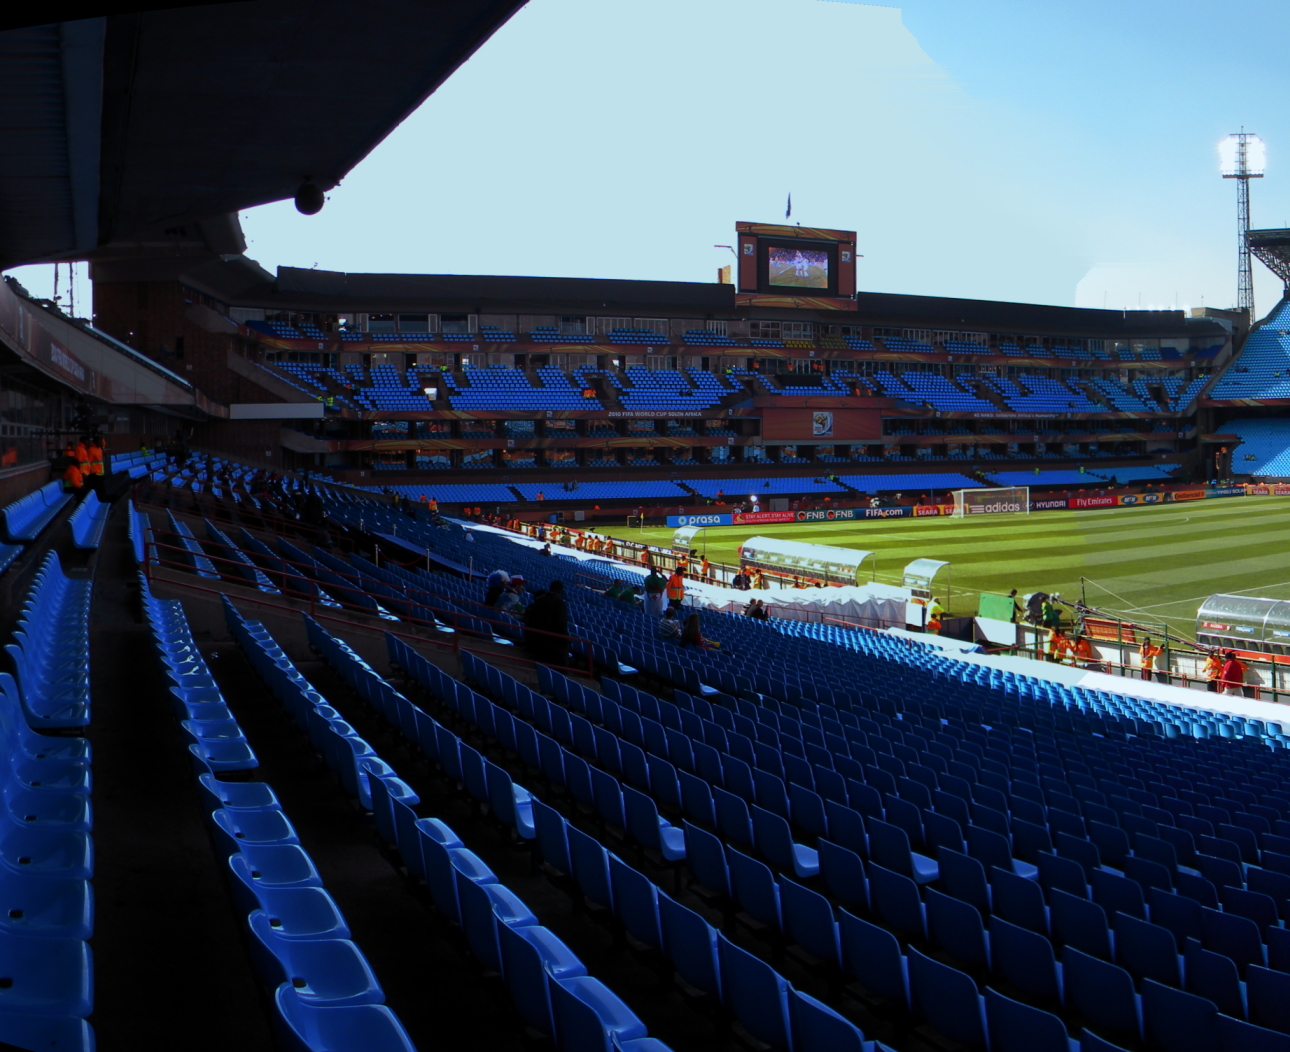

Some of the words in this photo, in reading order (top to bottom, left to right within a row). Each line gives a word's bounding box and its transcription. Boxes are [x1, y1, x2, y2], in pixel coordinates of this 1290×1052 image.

[1036, 500, 1066, 509] HYUNDAI
[1076, 498, 1087, 508] Fly
[1088, 497, 1112, 506] Emirates
[986, 502, 1020, 513] adidas
[806, 511, 824, 520] FNB
[835, 510, 854, 518] FNB
[866, 508, 903, 518] FIFA.com
[688, 516, 720, 525] prasa
